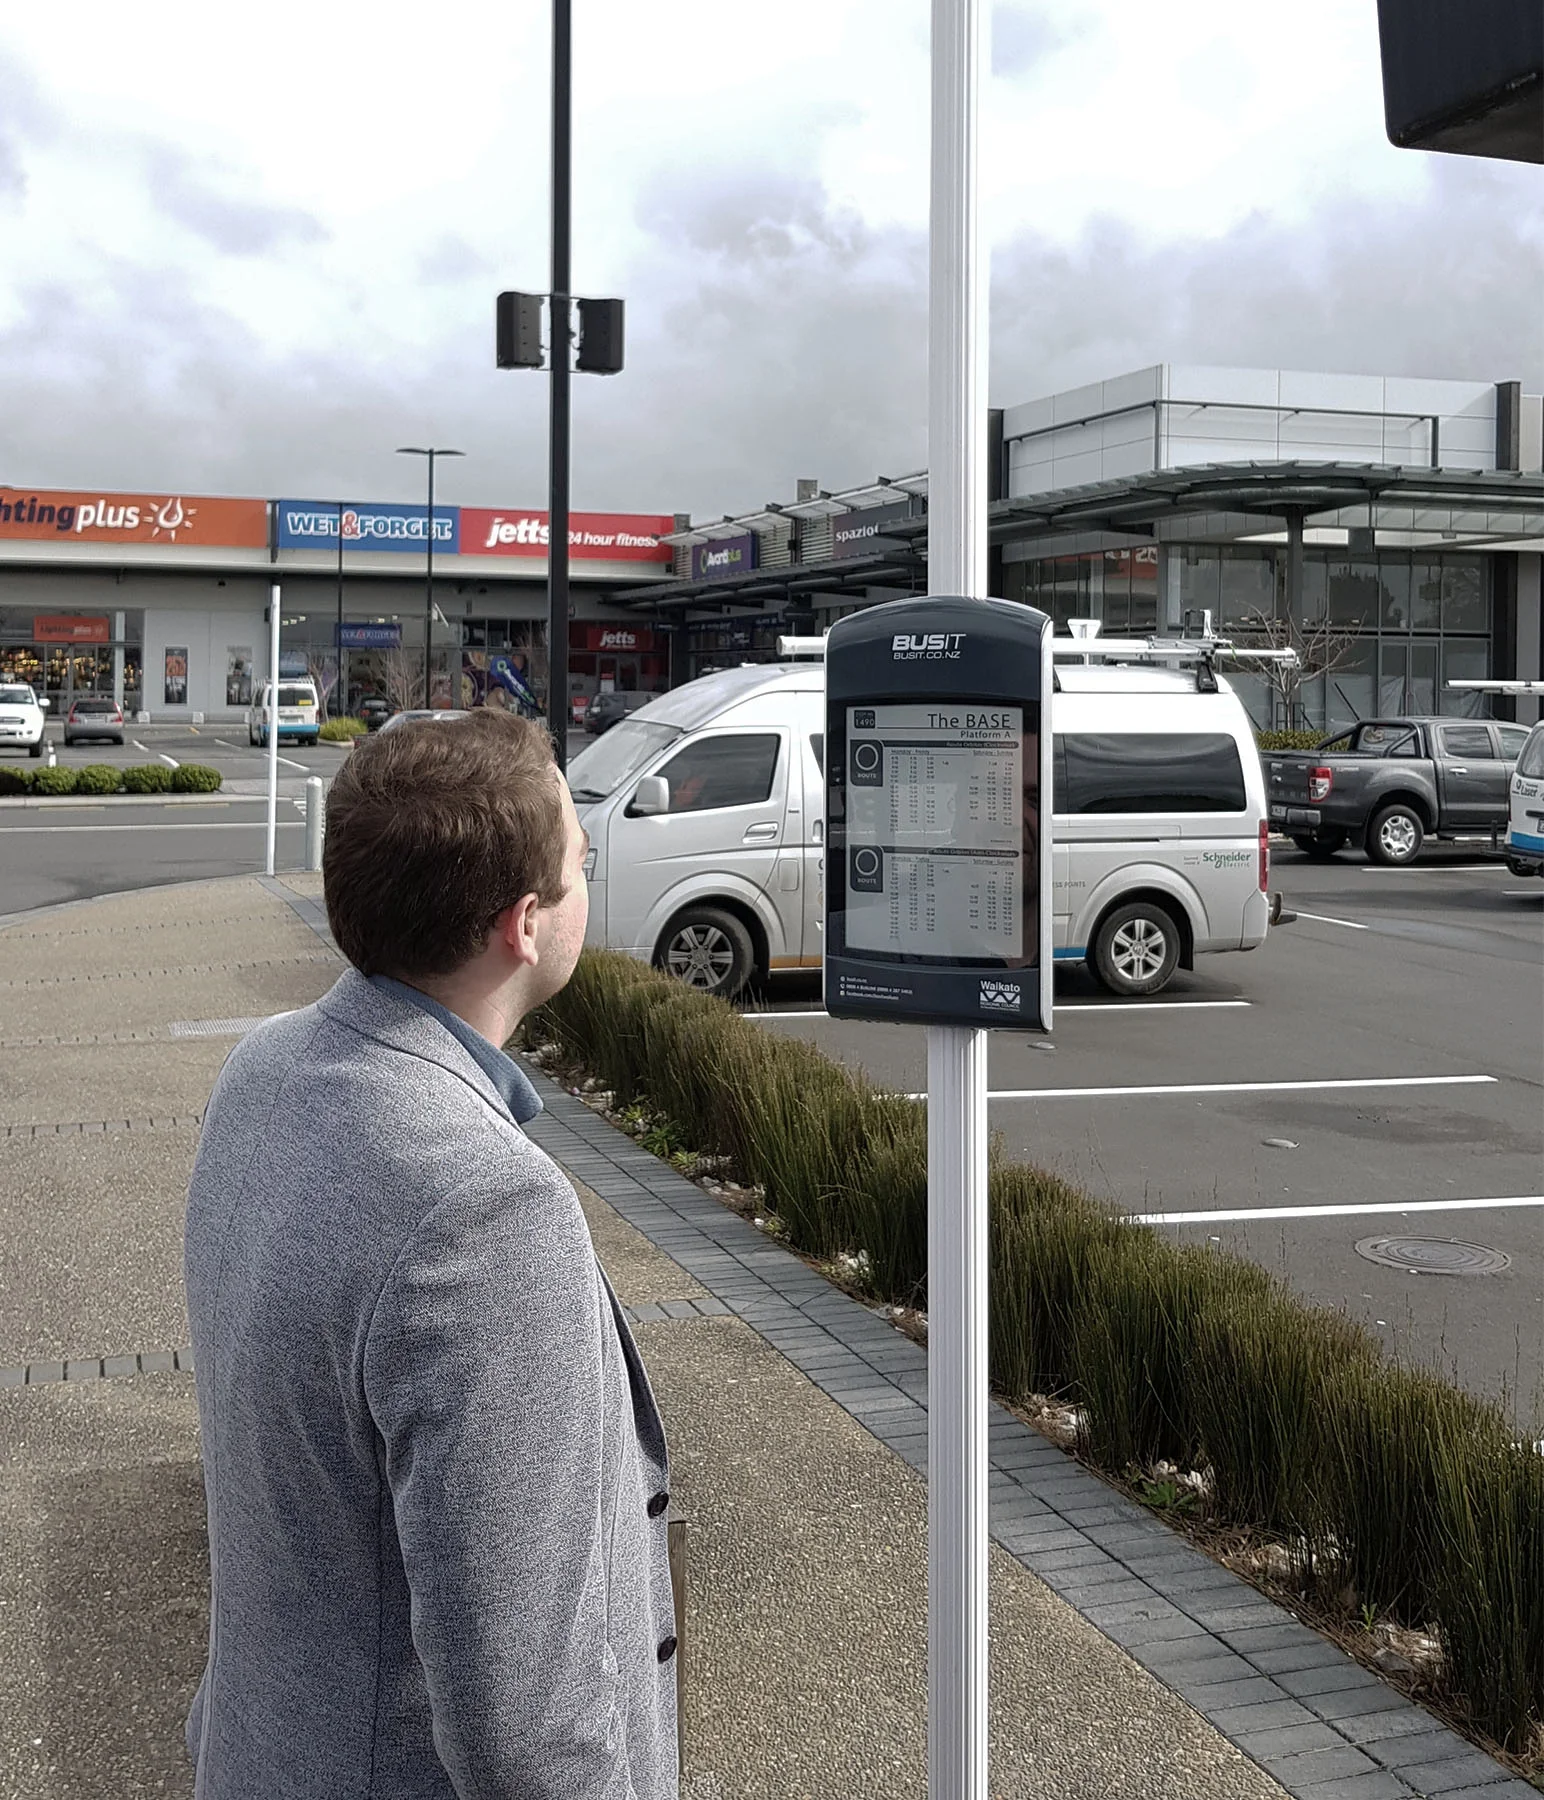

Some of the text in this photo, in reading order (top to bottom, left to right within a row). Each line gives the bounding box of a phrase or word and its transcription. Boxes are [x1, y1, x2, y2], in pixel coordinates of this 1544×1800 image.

[485, 517, 659, 548] jetts 24 hour fitness
[599, 630, 636, 648] jetts
[892, 633, 967, 650] BUSIT
[893, 651, 961, 660] BUSIT.CO.NZ
[855, 718, 875, 727] 1490
[927, 713, 1011, 728] The BASE
[960, 730, 1011, 739] Platform A
[1202, 851, 1251, 862] Schneider
[857, 877, 877, 885] ROUTE
[980, 980, 1021, 993] Waikato
